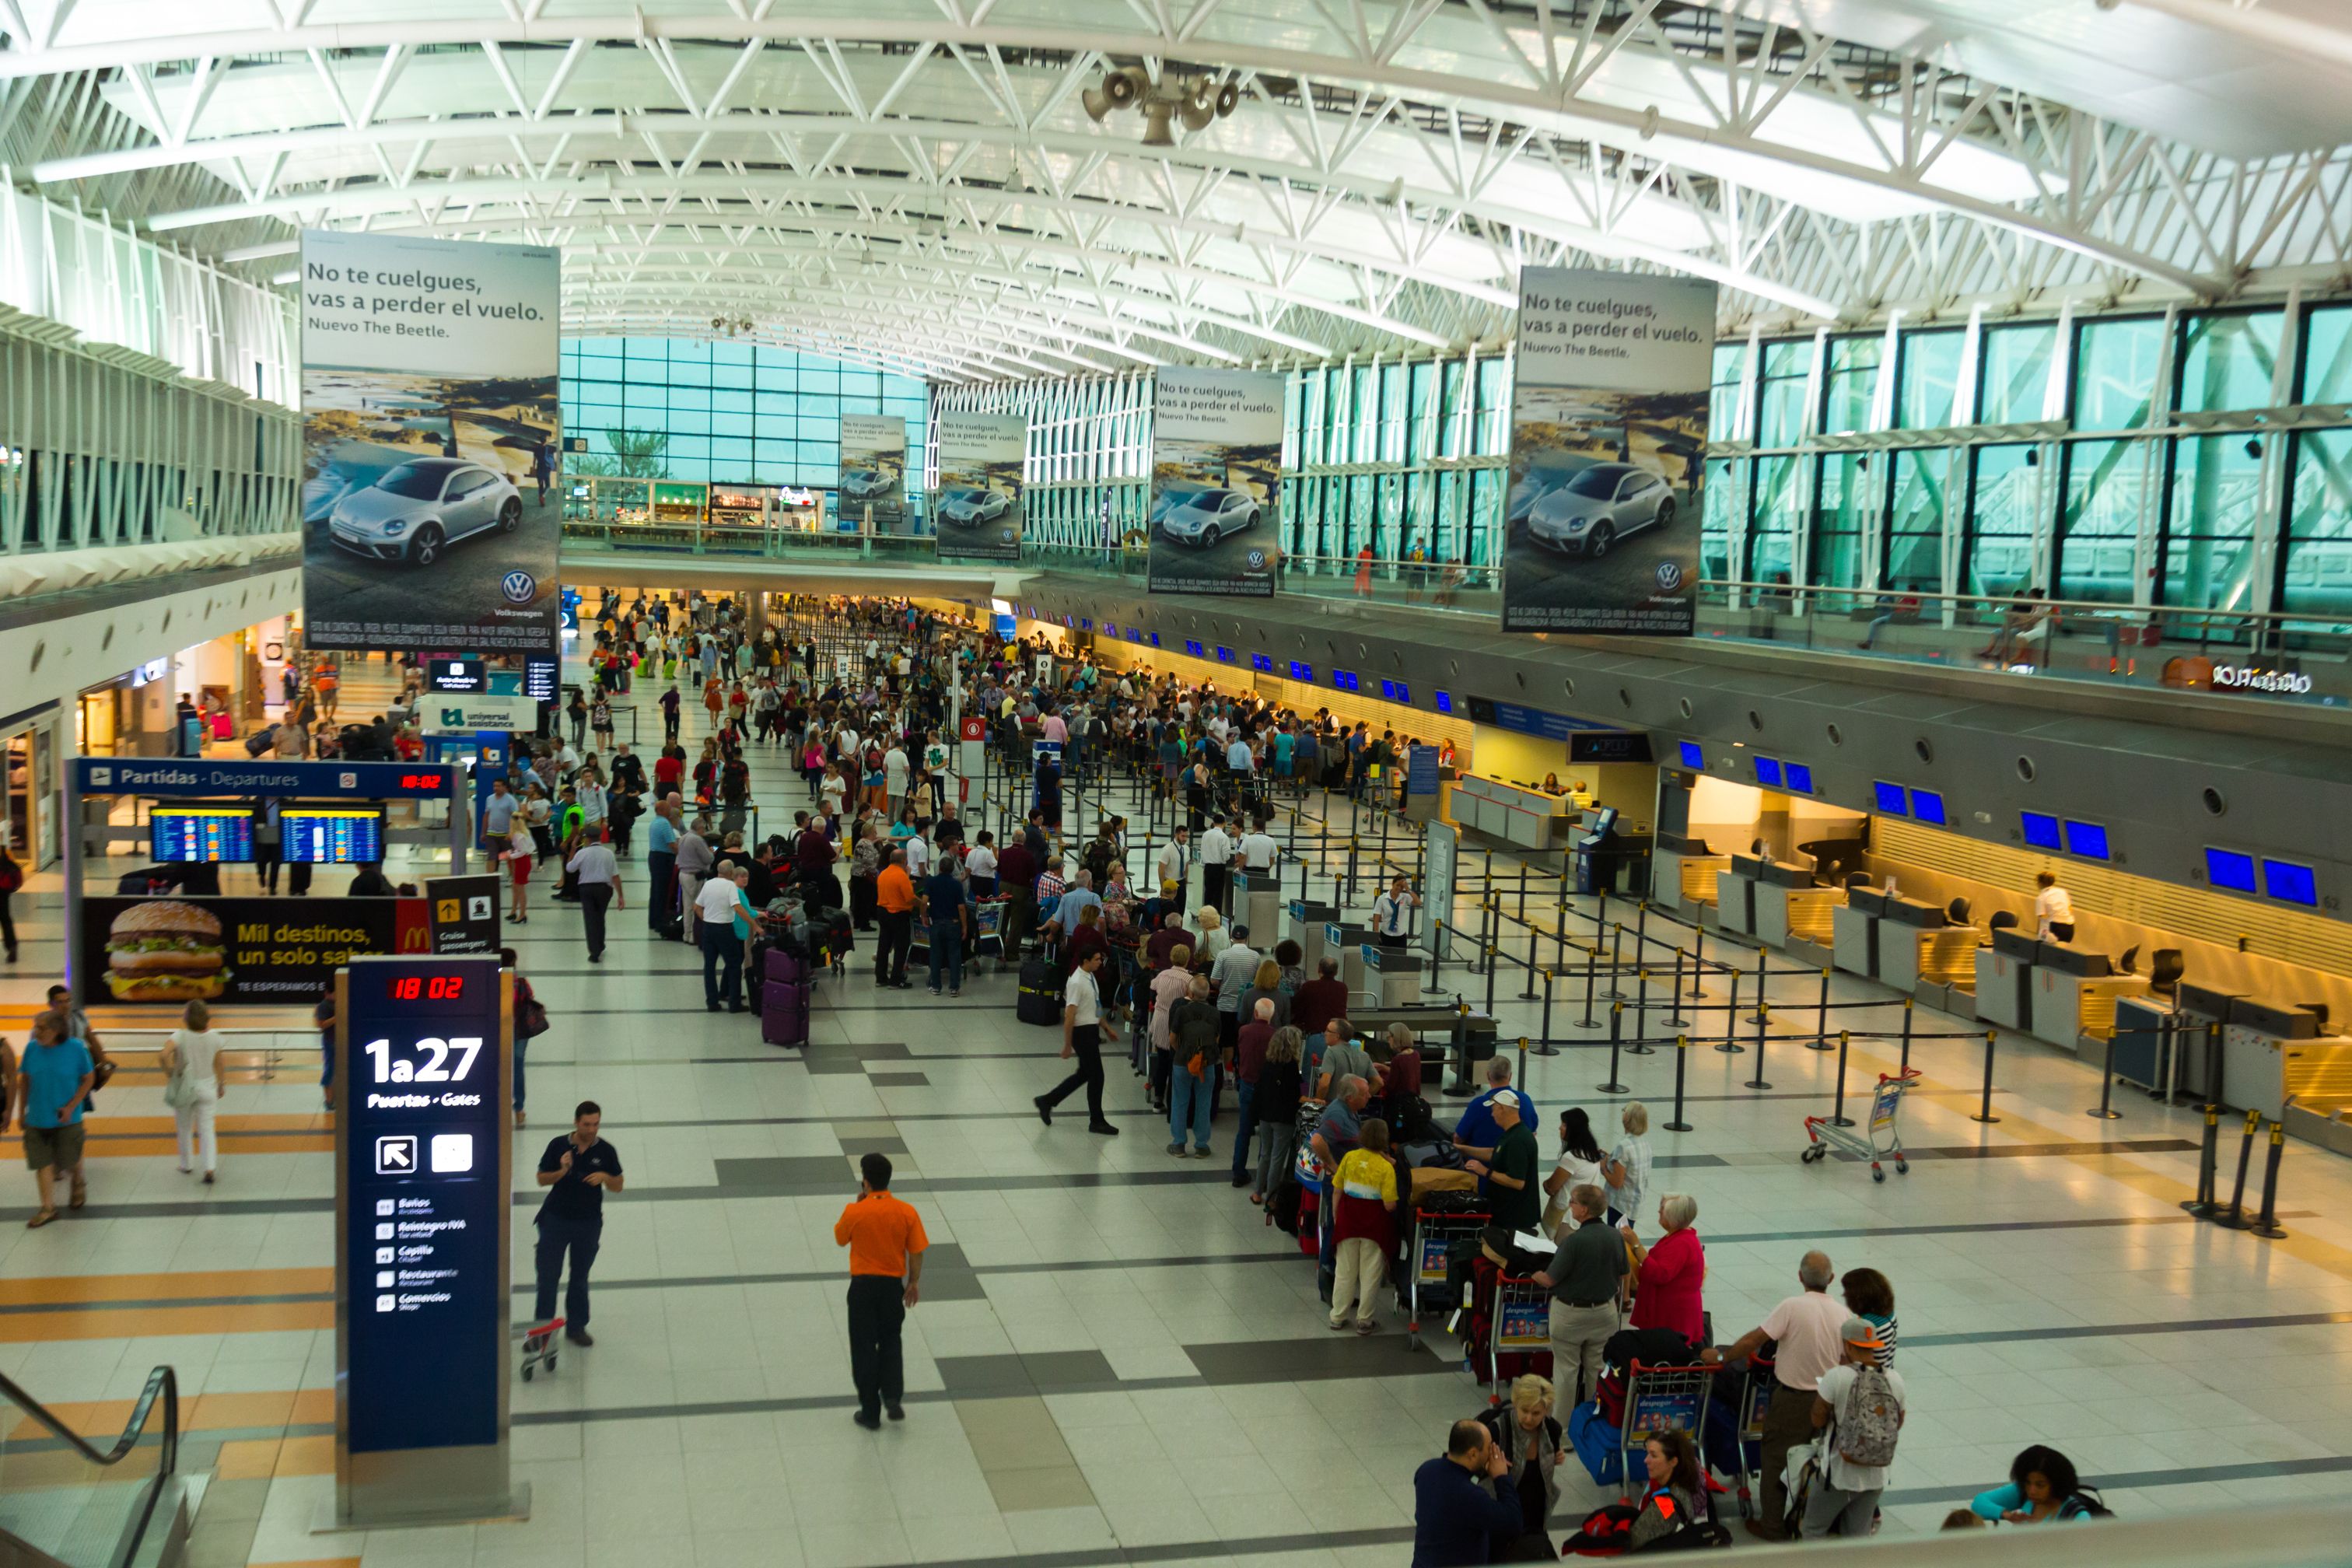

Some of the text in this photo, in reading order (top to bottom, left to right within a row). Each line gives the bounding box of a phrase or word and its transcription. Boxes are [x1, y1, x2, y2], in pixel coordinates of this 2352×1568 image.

[308, 263, 482, 296] No te cuelgues,
[307, 292, 544, 321] vas a perder el vuelo.
[1525, 293, 1657, 320] No te cuelgues,
[309, 317, 450, 338] Nuevo The Beetle.
[1524, 320, 1703, 343] vas a perder el vuelo.
[1523, 341, 1630, 359] Nuevo The Beetle.
[1160, 383, 1246, 399] No te cuelgues,
[1159, 398, 1178, 407] vas
[1191, 400, 1227, 411] perder
[1230, 401, 1240, 411] el
[1243, 403, 1276, 413] vuelo.
[965, 423, 1000, 433] cuelgues,
[494, 609, 544, 618] Volkswagen
[467, 712, 509, 721] universal
[121, 769, 300, 788] Partidas Departures
[237, 923, 371, 946] Mil destinos,
[439, 931, 467, 940] Cruise
[440, 940, 488, 953] passengers
[237, 950, 266, 964] un
[271, 947, 317, 965] solo
[237, 982, 251, 992] TE
[253, 982, 317, 992] ESPERAMOS
[367, 1092, 481, 1108] Puertas Gates
[398, 1292, 451, 1304] Comercios
